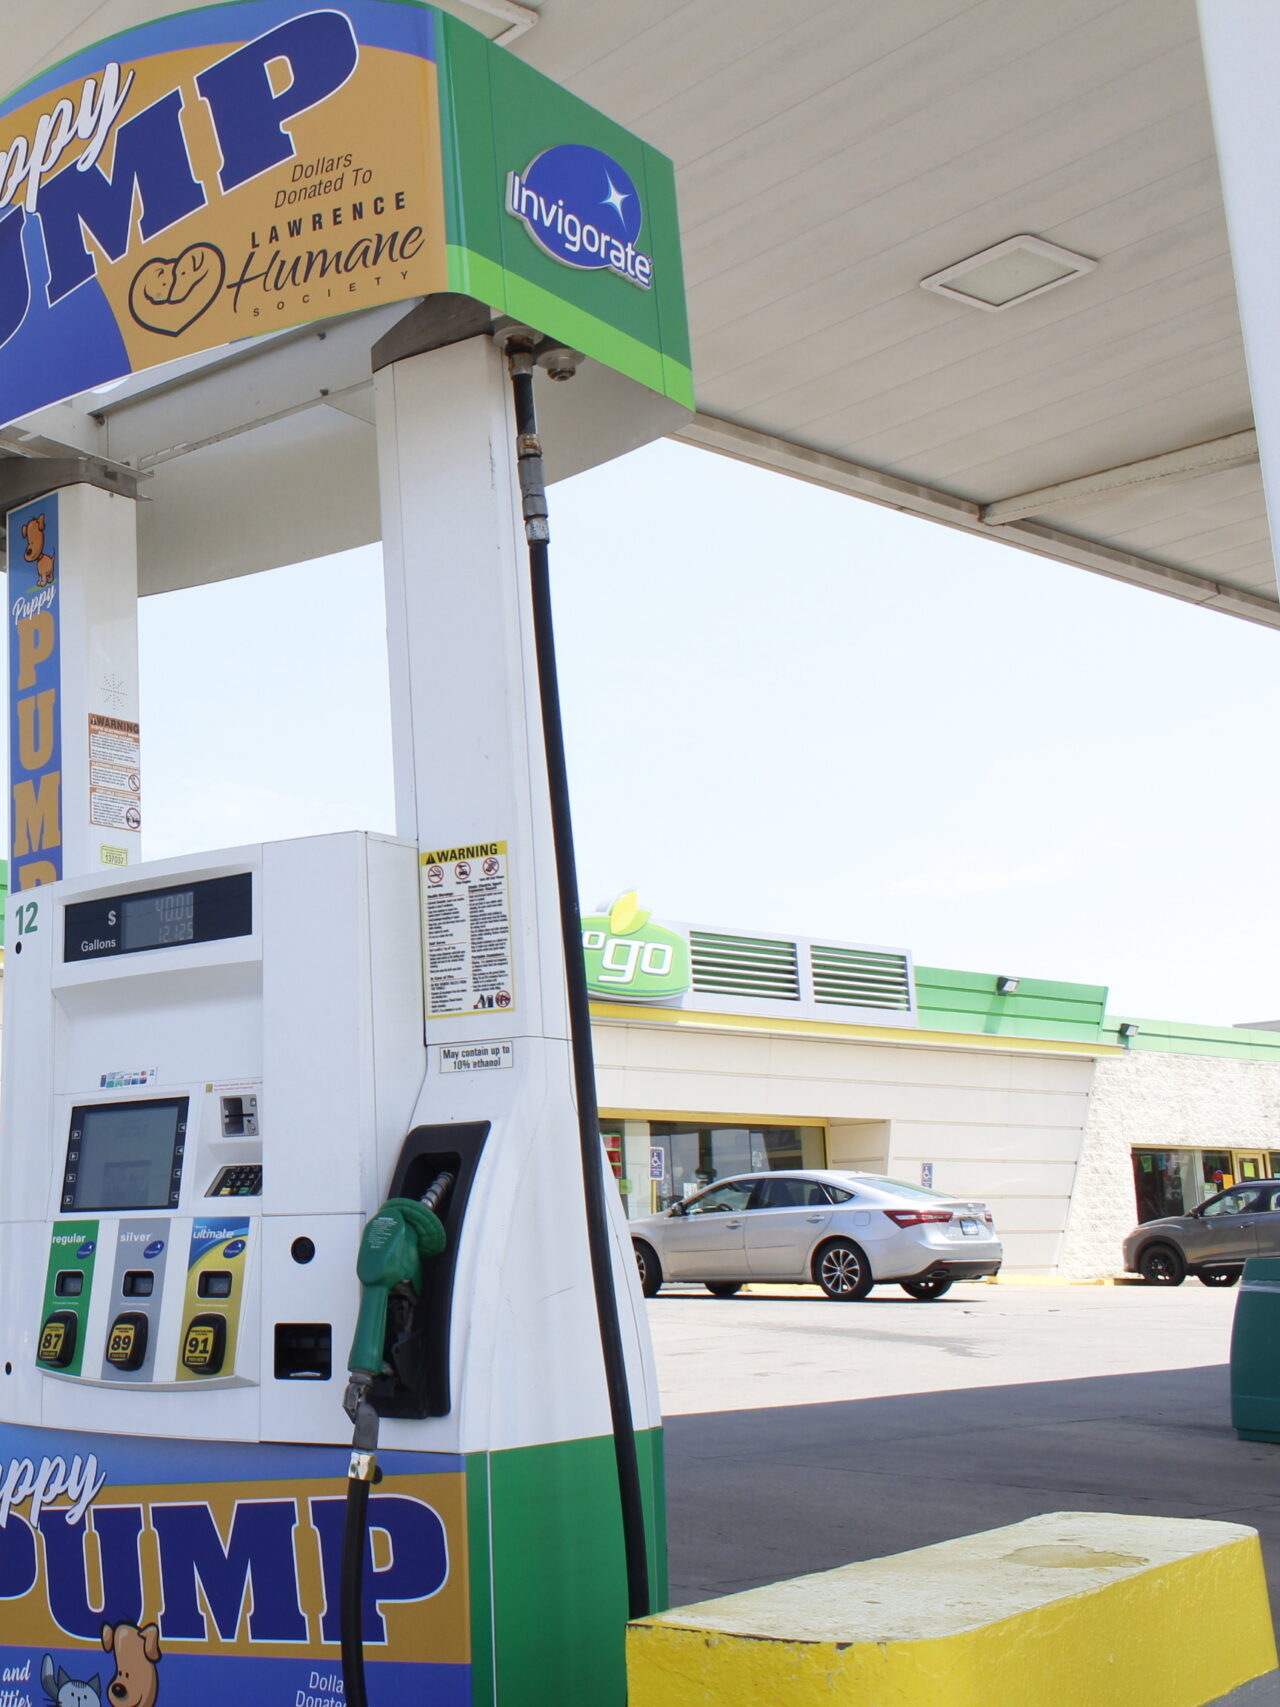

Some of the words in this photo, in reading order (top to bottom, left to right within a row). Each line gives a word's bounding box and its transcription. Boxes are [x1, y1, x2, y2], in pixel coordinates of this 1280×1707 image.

[291, 153, 353, 183] Dollars
[274, 173, 344, 209] Donated
[352, 168, 373, 187] To
[251, 191, 406, 249] LAWRENCE
[512, 175, 651, 285] Invigorate
[226, 226, 426, 313] Humane
[252, 270, 409, 317] SOCIETY
[12, 585, 57, 625] Puppy
[96, 715, 140, 735] WARNING
[436, 843, 498, 862] WARNING
[15, 901, 39, 936] 12
[108, 910, 116, 927] $
[81, 938, 117, 952] Gallons
[442, 1049, 459, 1059] May
[461, 1046, 489, 1057] contain
[490, 1047, 500, 1056] up
[502, 1045, 510, 1054] to
[453, 1059, 470, 1070] 10%
[472, 1057, 500, 1068] ethanol
[52, 1232, 86, 1246] regular
[120, 1231, 151, 1242] silver
[193, 1228, 234, 1239] ultimate
[42, 1333, 62, 1350] 87
[111, 1335, 132, 1351] 89
[188, 1337, 210, 1355] 91
[309, 1671, 344, 1694] Dolla
